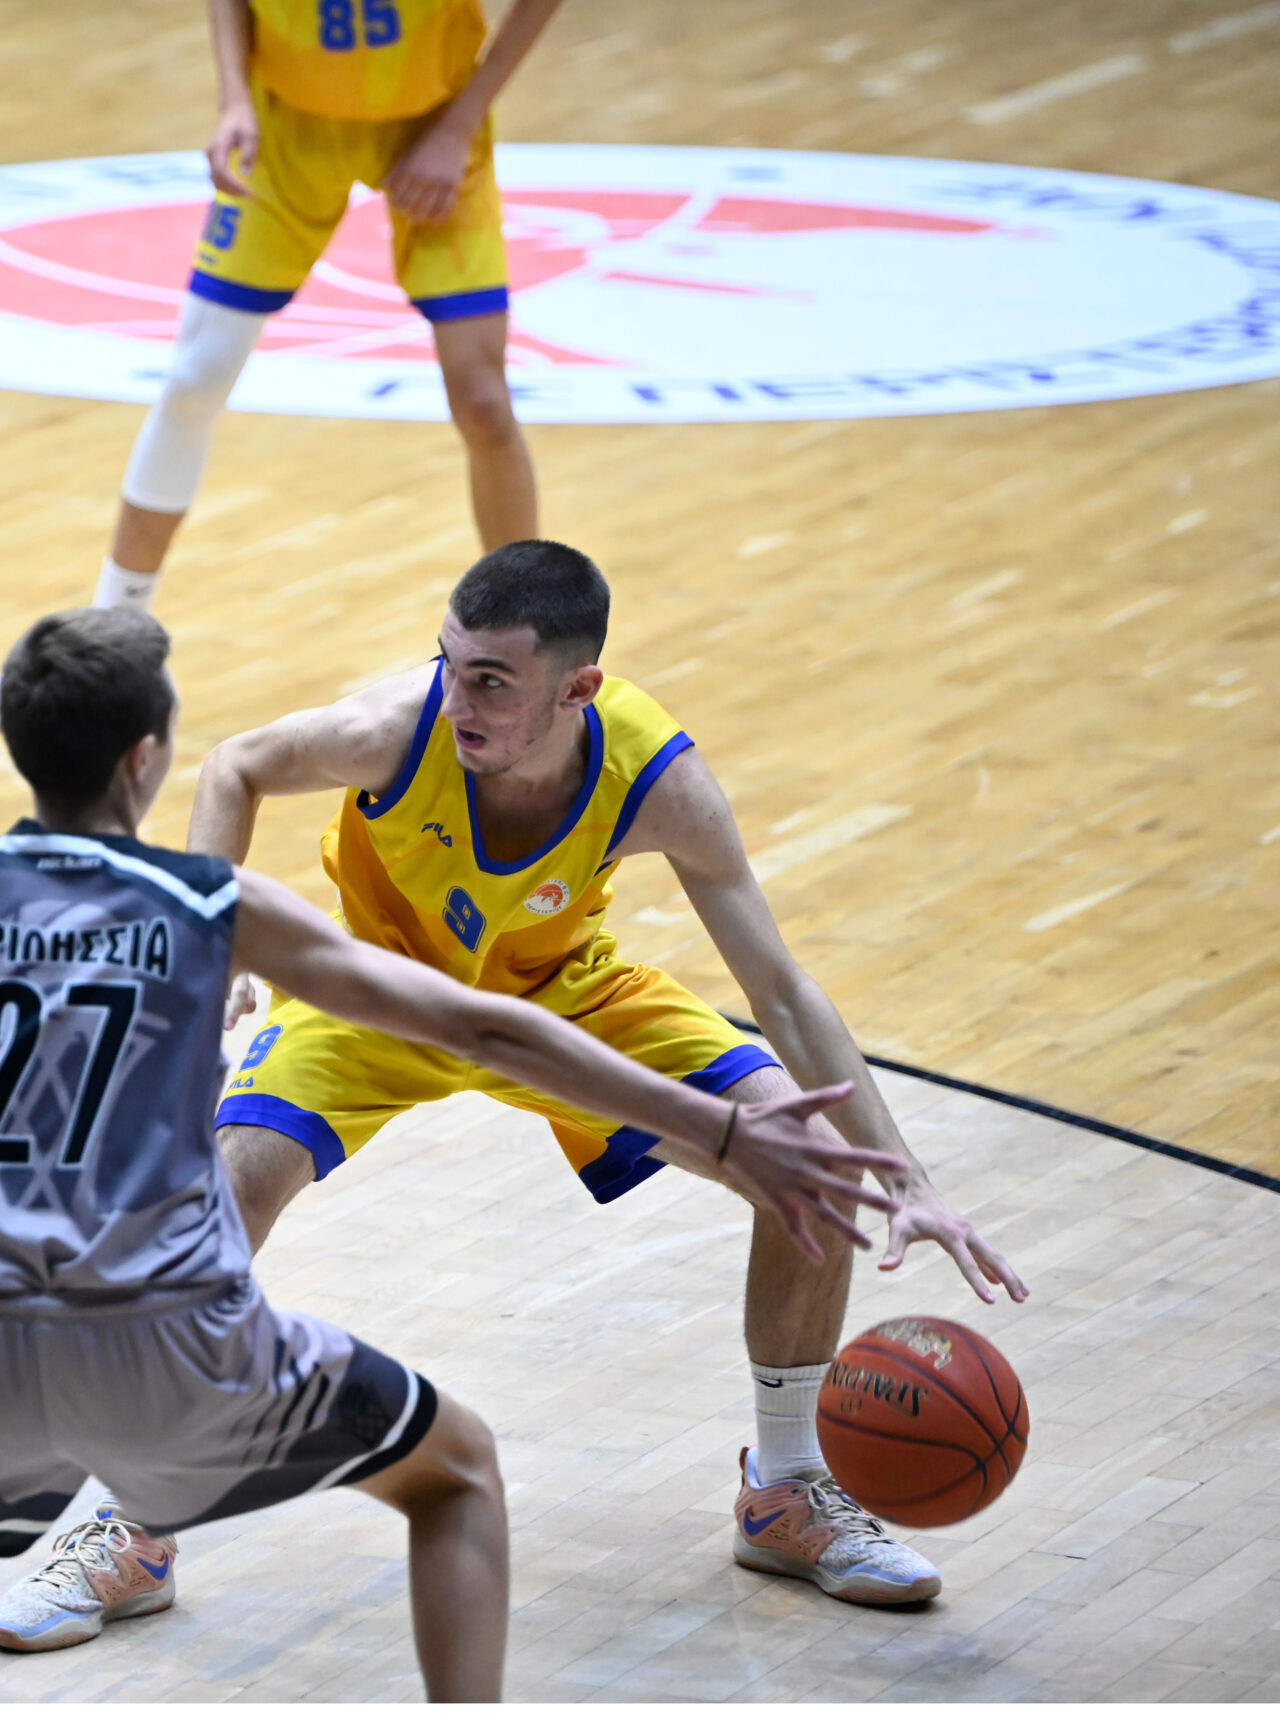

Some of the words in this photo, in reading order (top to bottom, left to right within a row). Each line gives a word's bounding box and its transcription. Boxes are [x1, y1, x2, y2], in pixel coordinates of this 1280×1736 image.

[316, 0, 402, 51] 85
[421, 822, 453, 848] FILA
[442, 886, 487, 954] 9
[238, 1023, 284, 1072] 9
